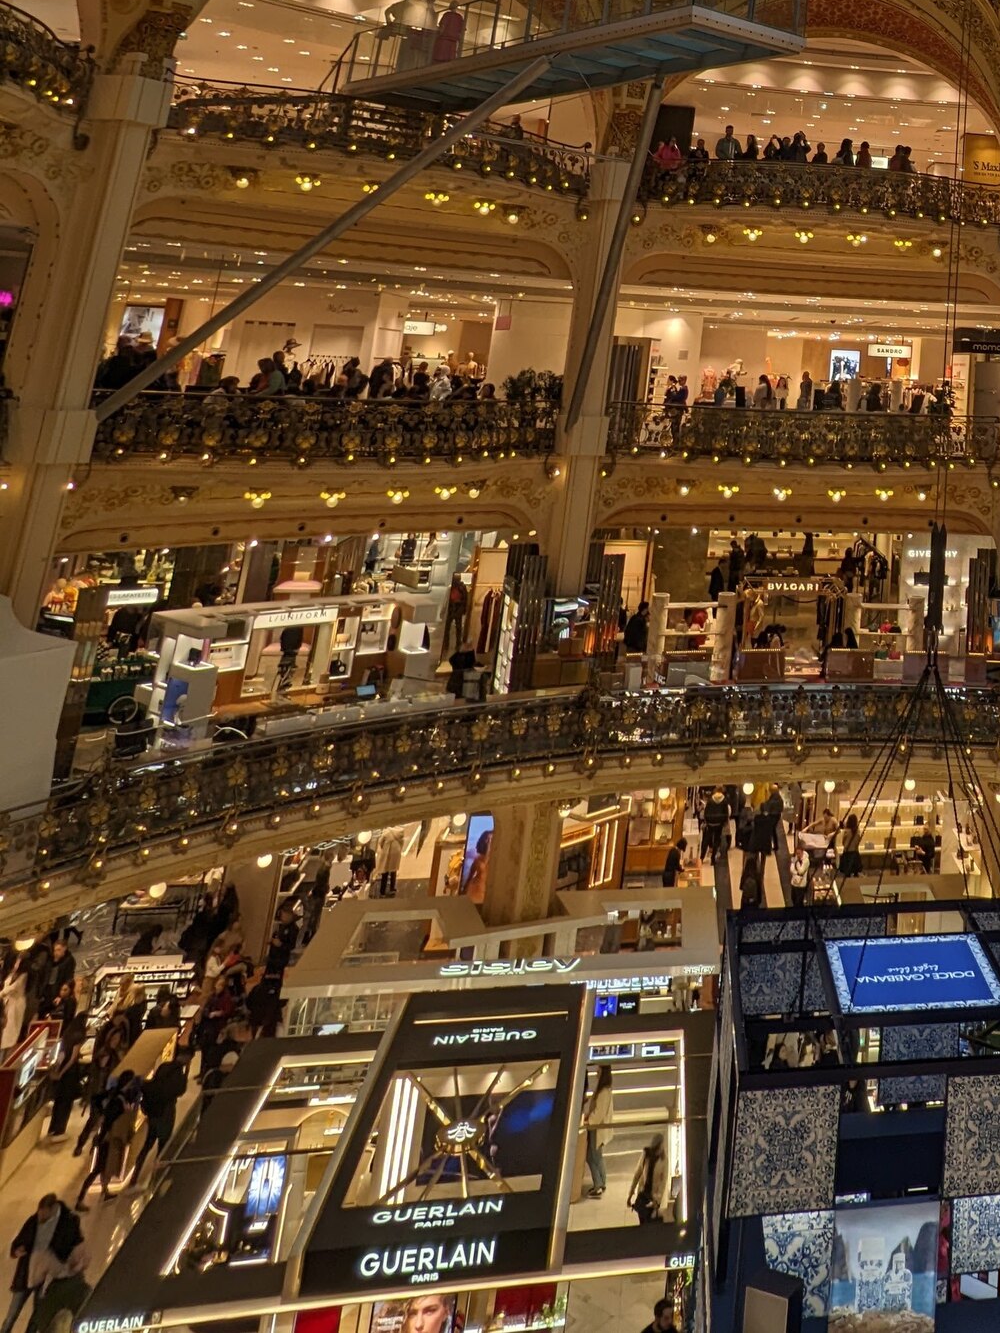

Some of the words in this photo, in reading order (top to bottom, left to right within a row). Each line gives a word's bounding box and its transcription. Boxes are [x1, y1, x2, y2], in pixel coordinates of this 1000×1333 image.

[908, 550, 958, 558] GIVEHY
[768, 582, 819, 591] BVLGARI
[440, 956, 581, 977] sisley
[433, 1030, 537, 1046] GUERLAIN
[372, 1200, 503, 1224] GUERLAIN
[414, 1219, 455, 1229] PARIS
[360, 1240, 496, 1276] GUERLAIN
[670, 1255, 695, 1268] GUE
[411, 1272, 439, 1284] PARIS
[78, 1315, 144, 1333] GUERLAIN
